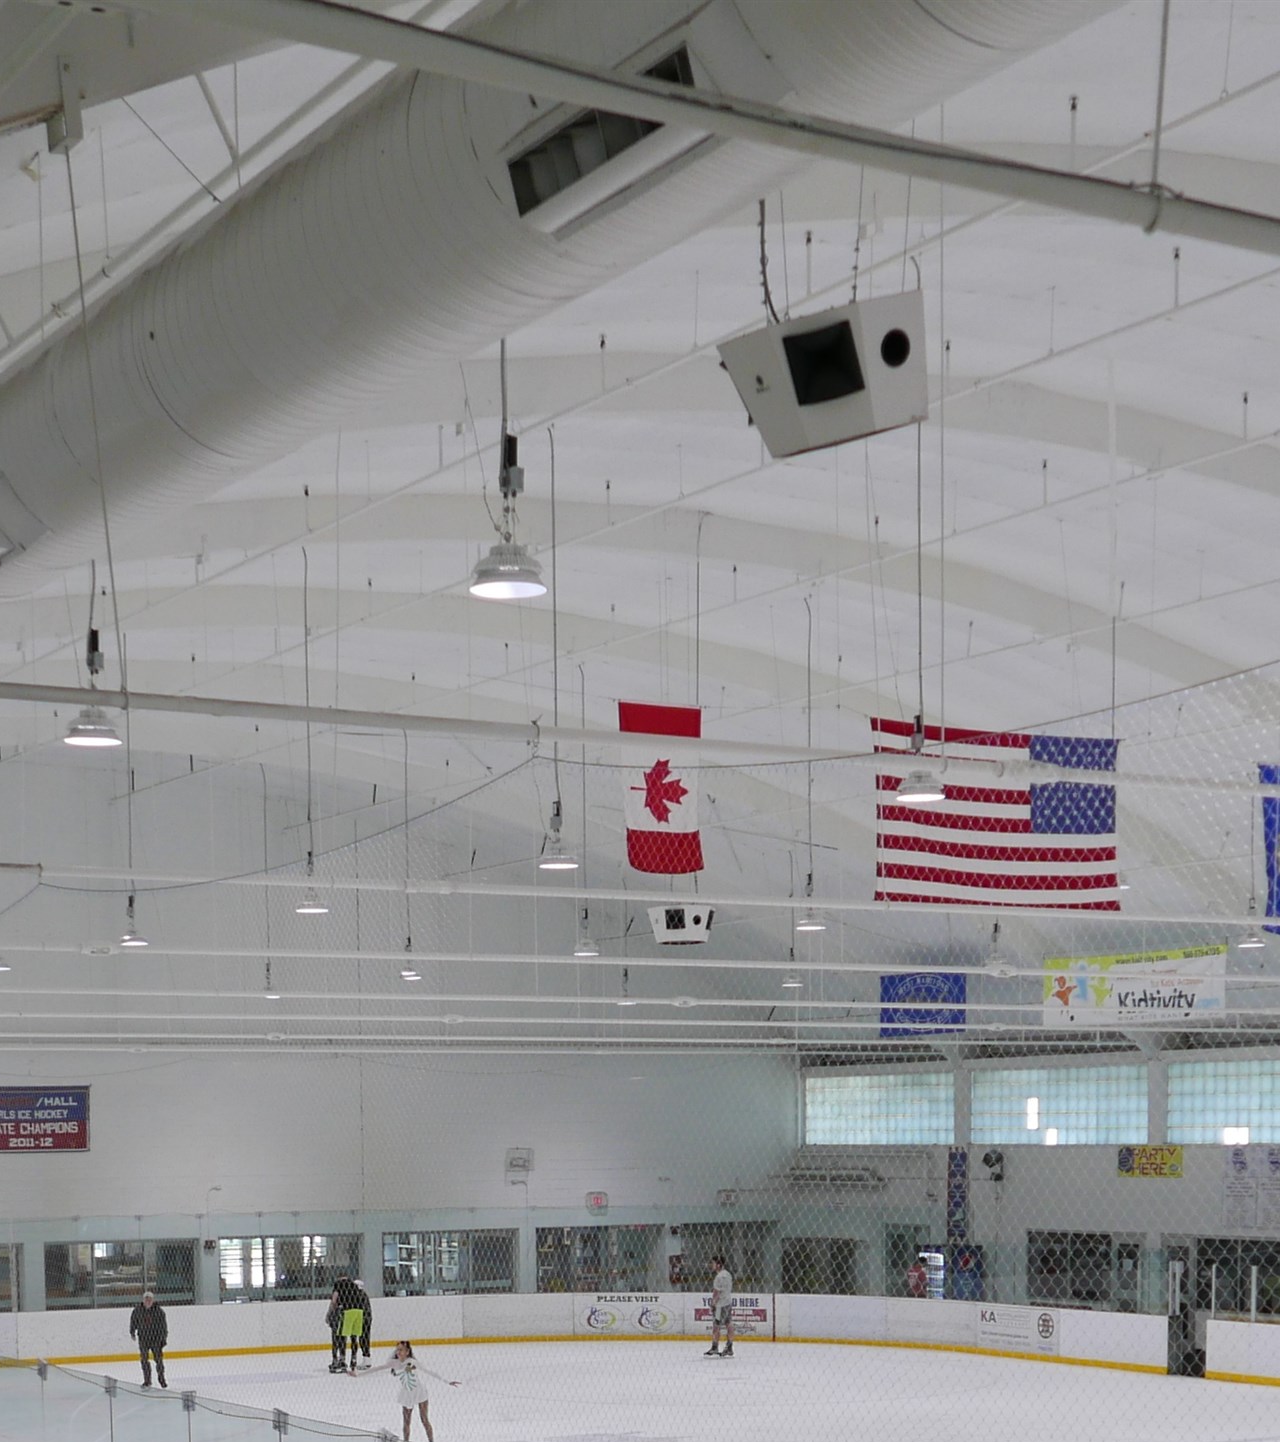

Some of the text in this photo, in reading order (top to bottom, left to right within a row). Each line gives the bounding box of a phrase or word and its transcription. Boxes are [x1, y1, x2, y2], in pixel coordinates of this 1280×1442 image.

[1117, 987, 1196, 1012] Kidtivity
[18, 1109, 32, 1119] ICE
[34, 1109, 68, 1119] HOCKEY
[20, 1121, 78, 1134] CHAMPIONS
[9, 1137, 53, 1147] 2011-12
[1132, 1147, 1177, 1161] PARTY
[1132, 1162, 1167, 1176] HERE
[597, 1295, 660, 1303] PLEASE VISIT
[739, 1297, 760, 1308] HERE
[980, 1310, 997, 1323] KA
